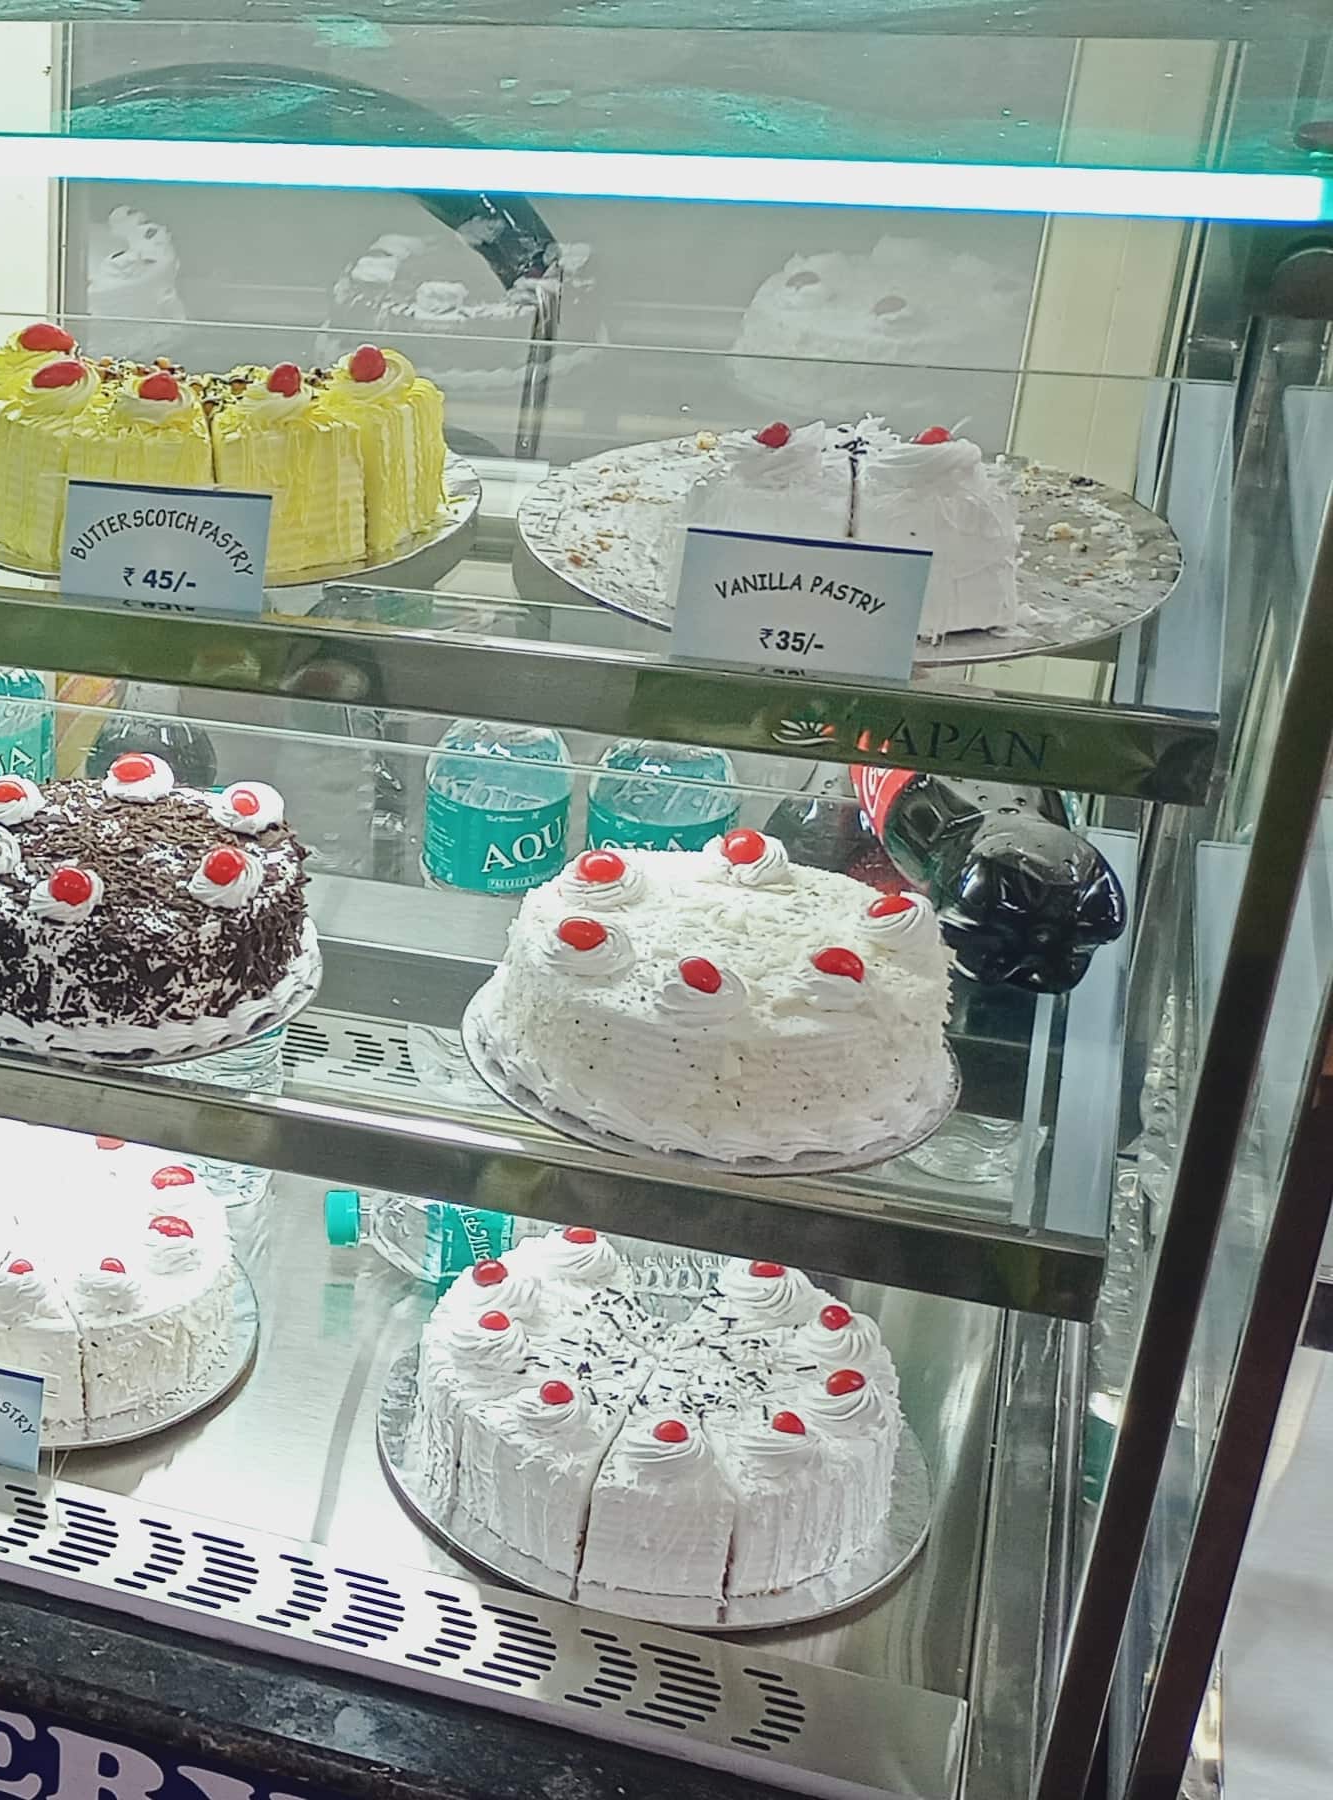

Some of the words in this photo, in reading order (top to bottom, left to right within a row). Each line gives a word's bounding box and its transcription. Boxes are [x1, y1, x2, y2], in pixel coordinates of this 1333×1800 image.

[70, 512, 132, 560] BUTTER
[197, 520, 254, 576] PASTRY
[714, 572, 803, 599] VANILLA
[809, 575, 886, 615] PASTRY
[481, 815, 567, 873] AQU
